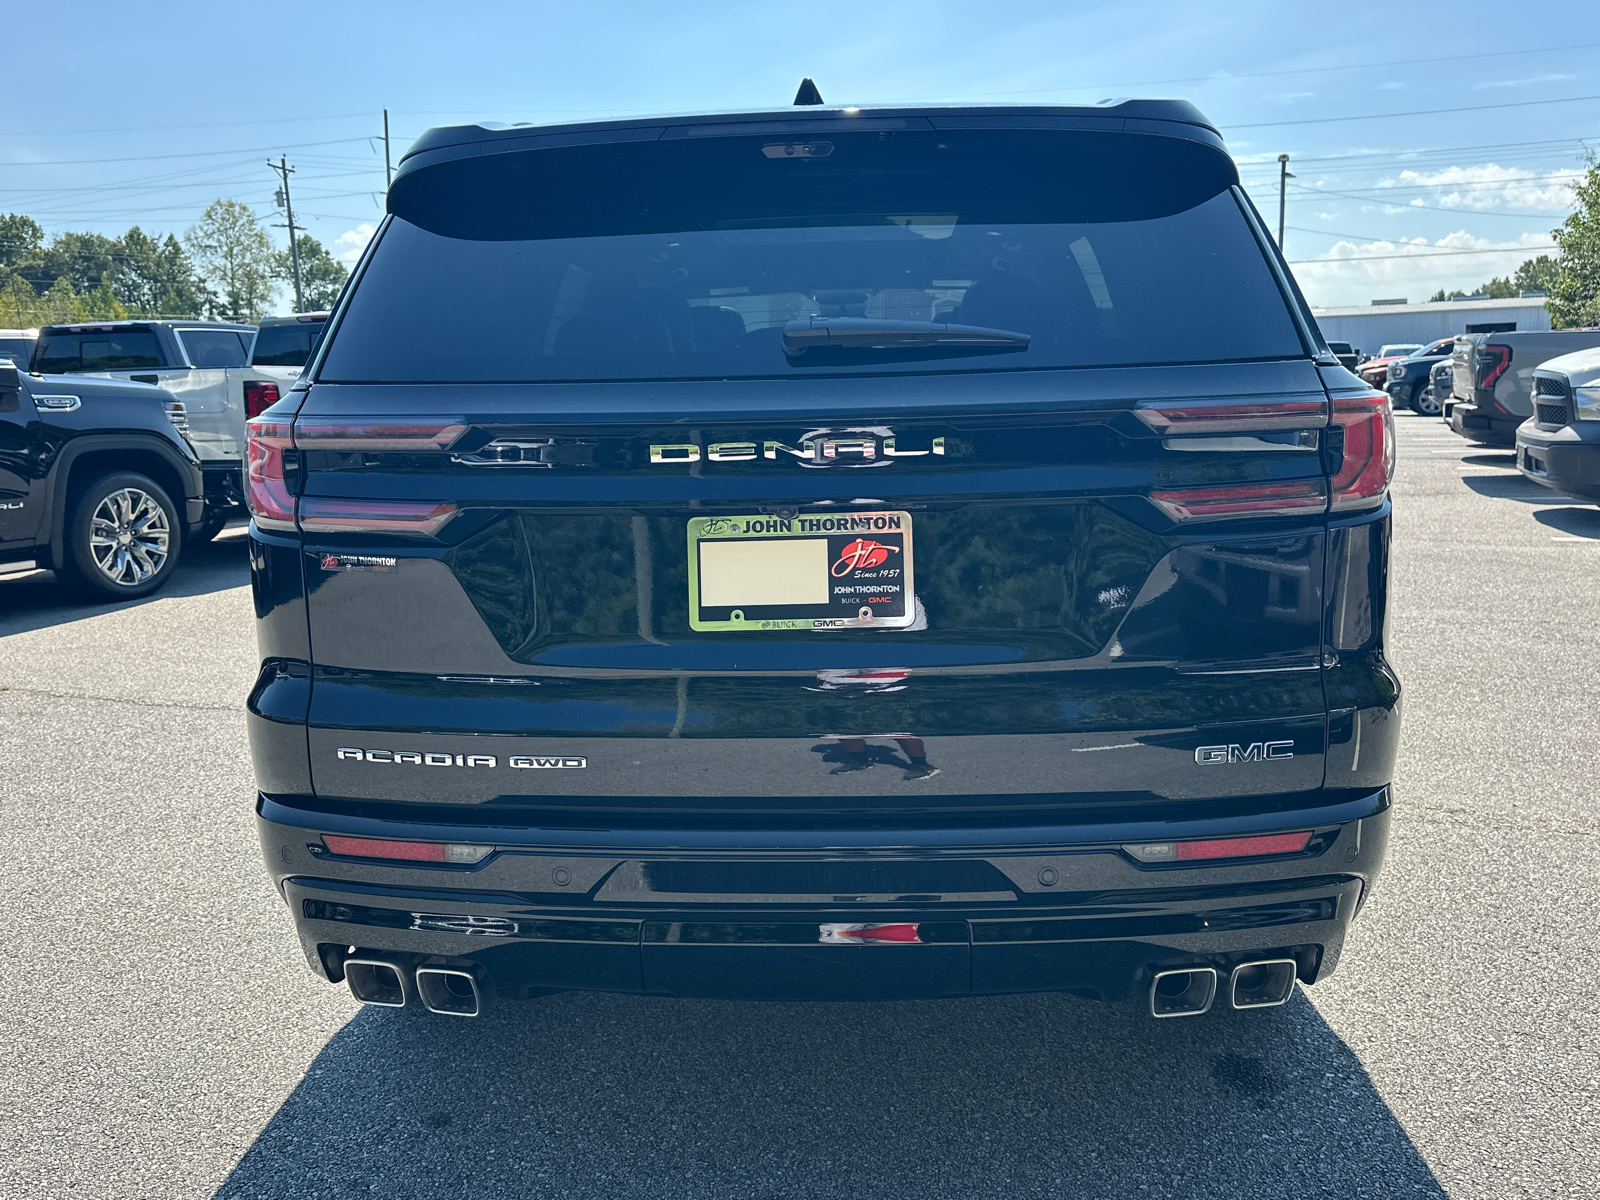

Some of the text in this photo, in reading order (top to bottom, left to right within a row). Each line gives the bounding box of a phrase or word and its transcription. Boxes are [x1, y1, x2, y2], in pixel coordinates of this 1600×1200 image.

[650, 437, 945, 463] DENALI
[742, 519, 792, 534] JOHN
[797, 515, 901, 532] THORNTON
[358, 556, 396, 566] THORNTON
[853, 569, 901, 579] Since 1957
[833, 584, 900, 594] JOHN THORNTON
[868, 596, 892, 604] GMC
[772, 619, 844, 629] BUICK GMC
[337, 747, 497, 768] ACADIA
[1195, 739, 1294, 766] GMC
[512, 756, 585, 768] AWD
